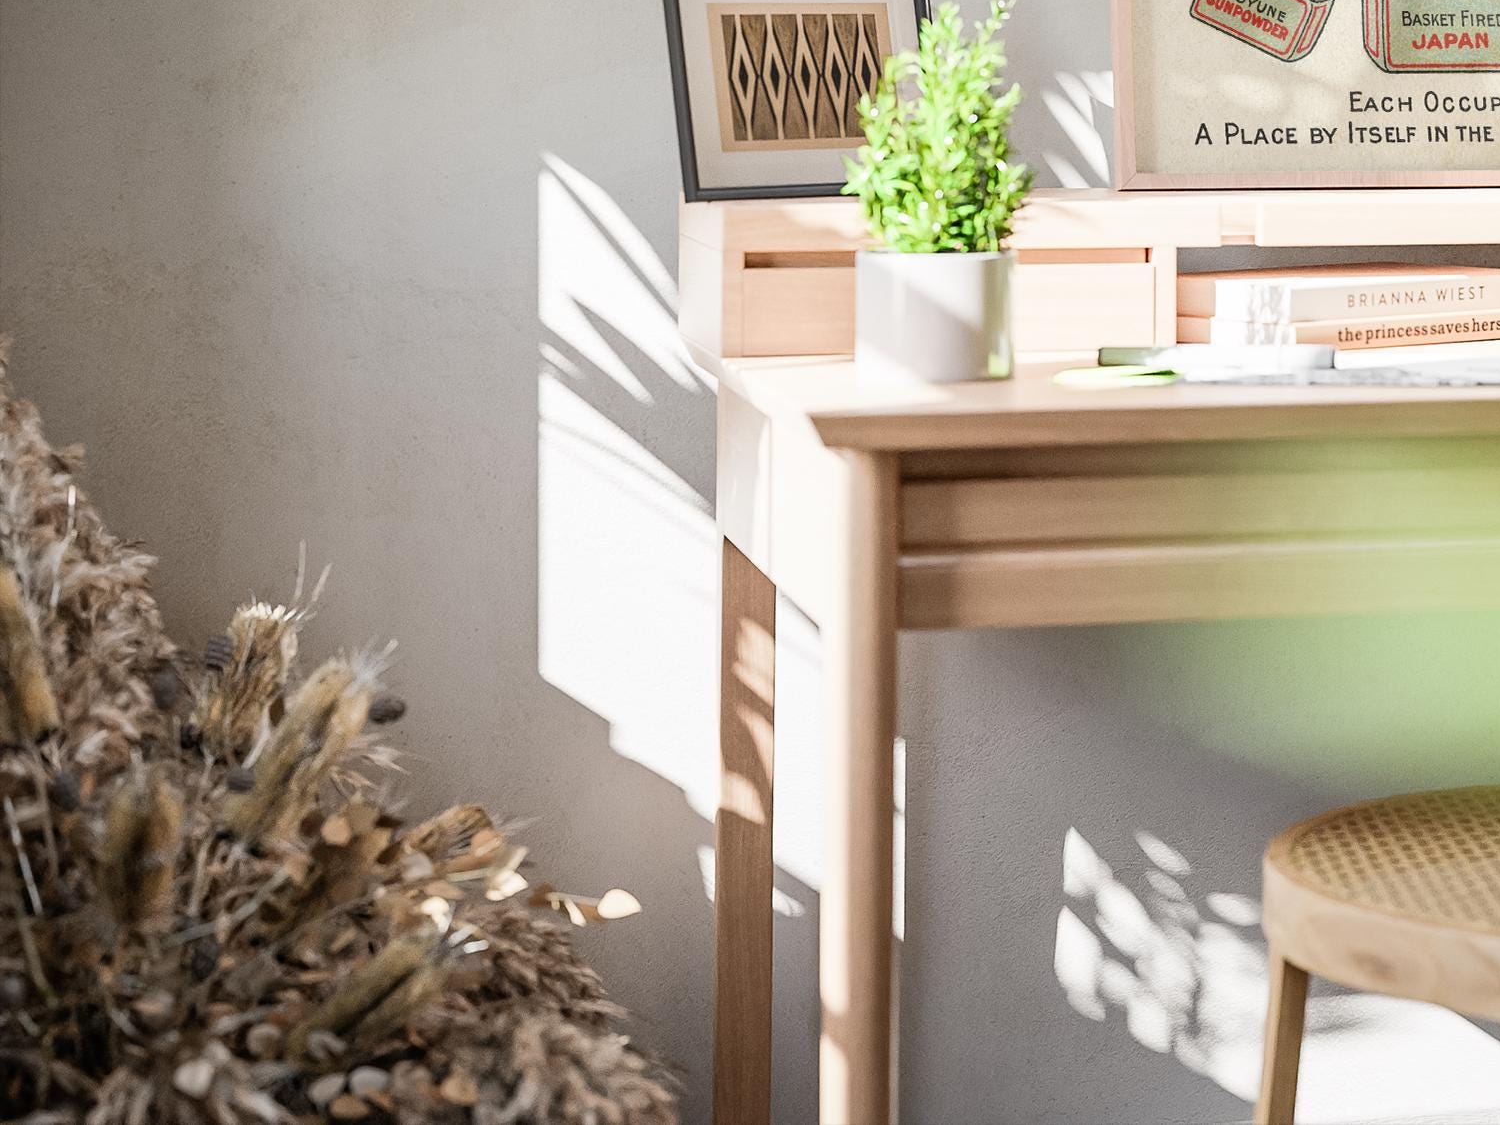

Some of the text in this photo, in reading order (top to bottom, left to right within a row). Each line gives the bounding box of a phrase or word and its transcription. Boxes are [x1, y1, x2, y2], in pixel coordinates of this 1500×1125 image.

[1402, 11, 1457, 27] BASKET
[1412, 32, 1489, 50] JAPAN
[1350, 91, 1412, 112] EACH
[1195, 123, 1212, 145] A
[1225, 123, 1297, 145] PLACE
[1310, 128, 1338, 144] BY
[1349, 121, 1416, 144] ITSELF
[1427, 125, 1448, 143] IN
[1456, 126, 1494, 142] THE
[1348, 286, 1485, 308] BRIANNA WIEST
